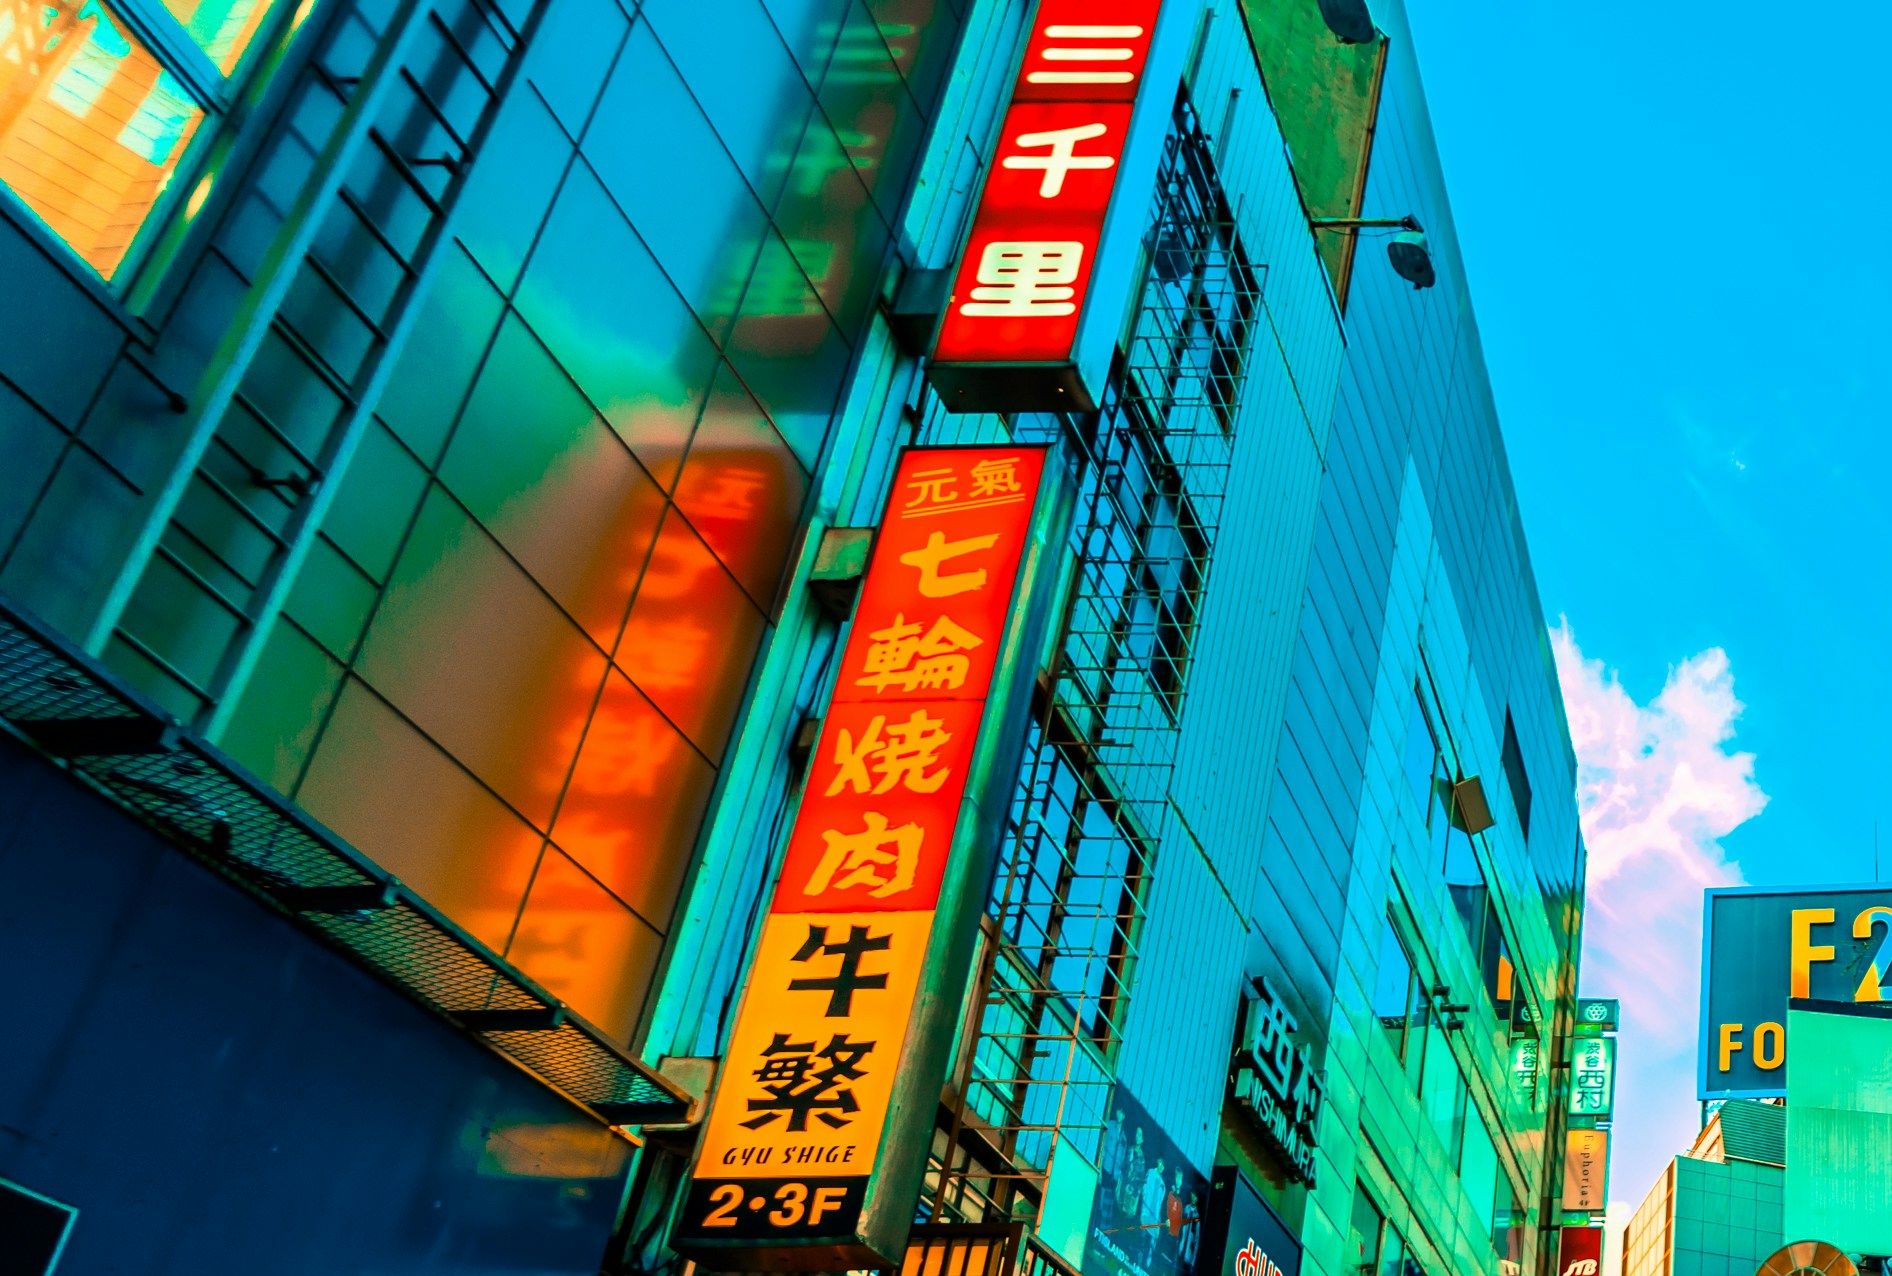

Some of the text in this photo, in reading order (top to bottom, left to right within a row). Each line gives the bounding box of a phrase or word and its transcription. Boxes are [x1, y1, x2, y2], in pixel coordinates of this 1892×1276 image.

[959, 25, 1143, 317] 三千里
[738, 923, 892, 1133] 牛繁
[1246, 1074, 1318, 1185] NISHIMURA
[1576, 1069, 1606, 1110] 西村
[721, 1144, 856, 1167] GYU SHIGE
[1580, 1134, 1594, 1197] Euphoria
